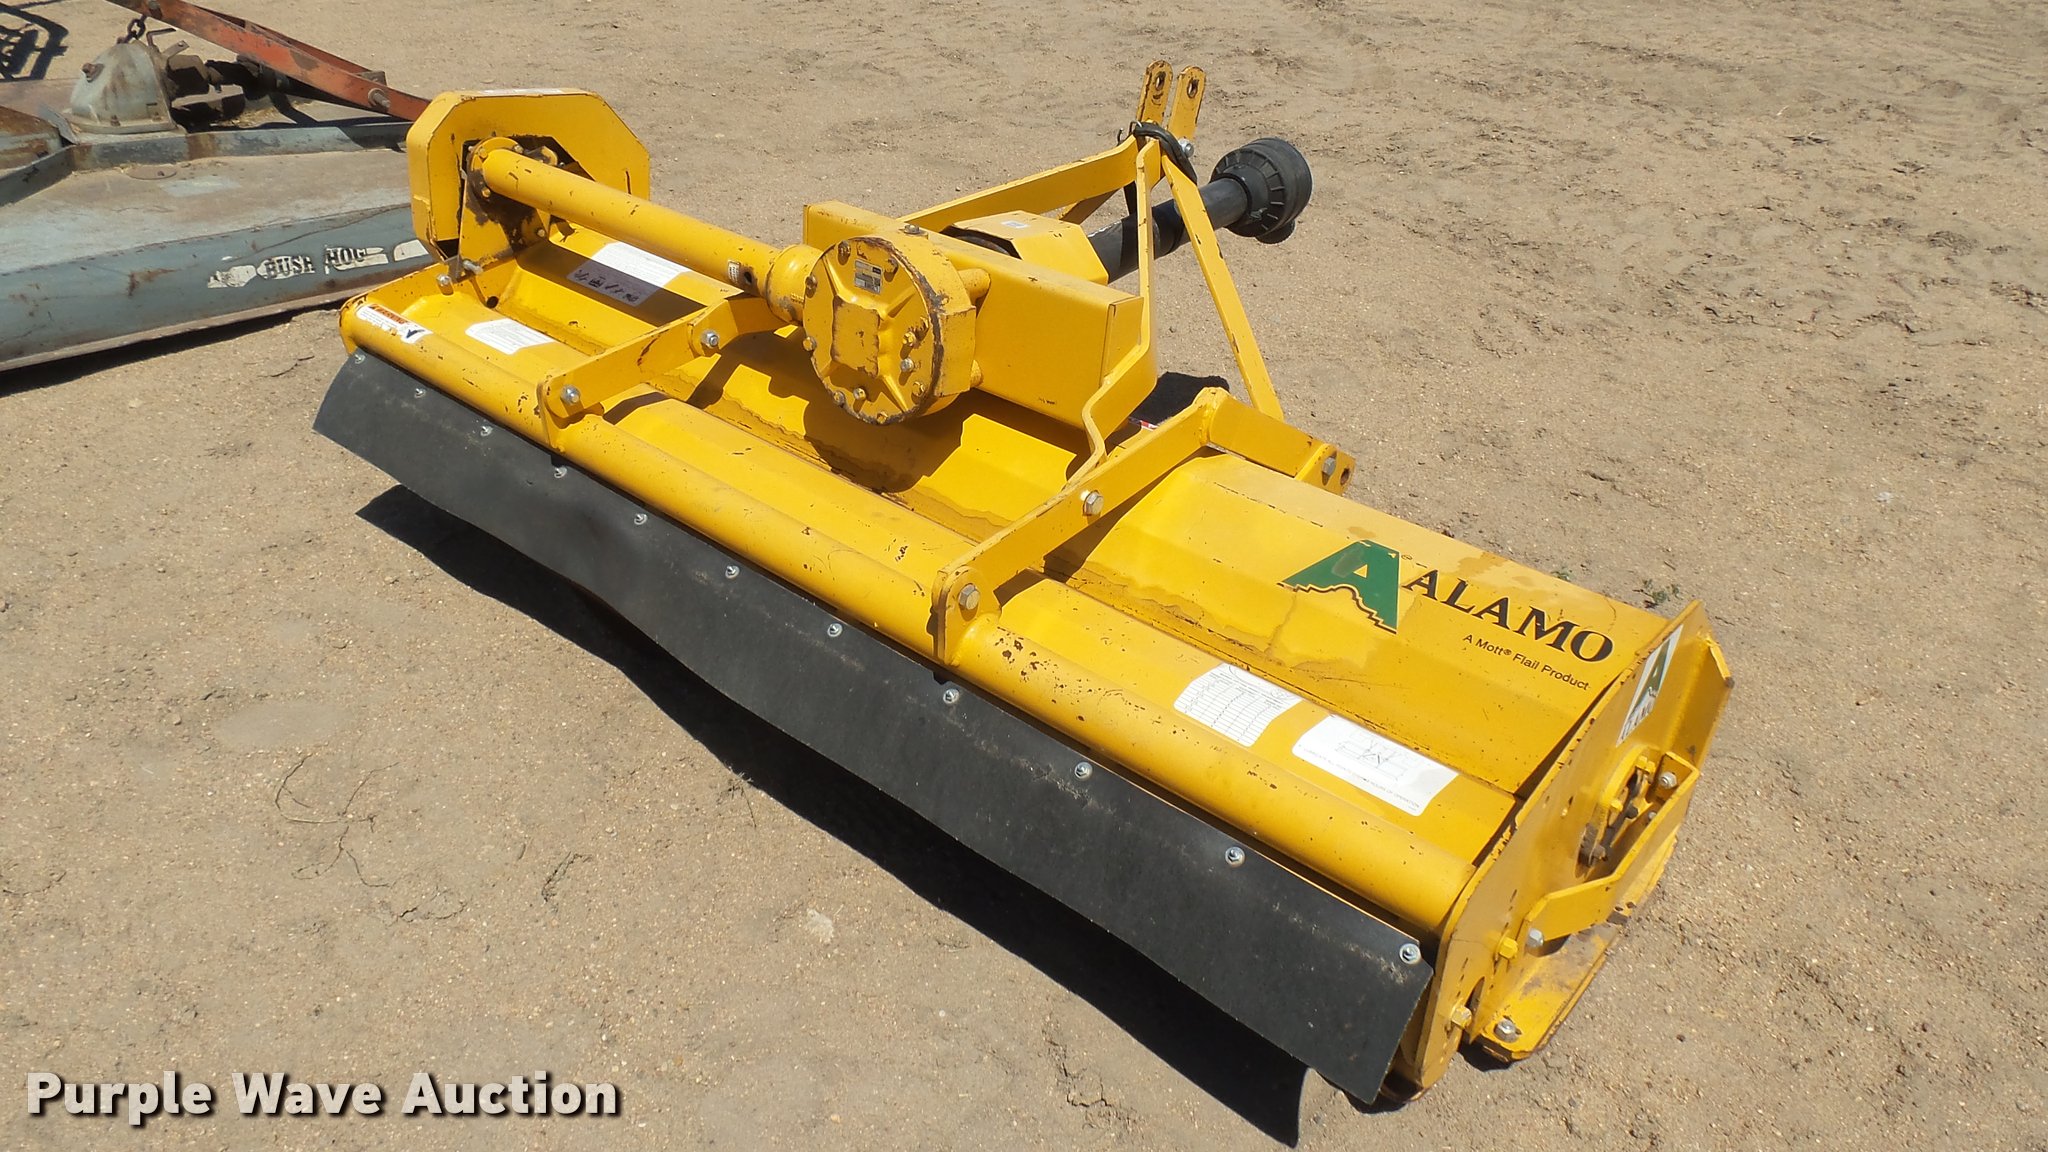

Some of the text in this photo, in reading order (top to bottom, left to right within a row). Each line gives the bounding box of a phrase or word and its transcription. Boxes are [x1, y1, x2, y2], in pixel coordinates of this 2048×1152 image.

[1401, 569, 1614, 663] ALAMO
[1463, 634, 1473, 644] A
[1512, 653, 1540, 670] Flail
[1541, 664, 1590, 691] Product
